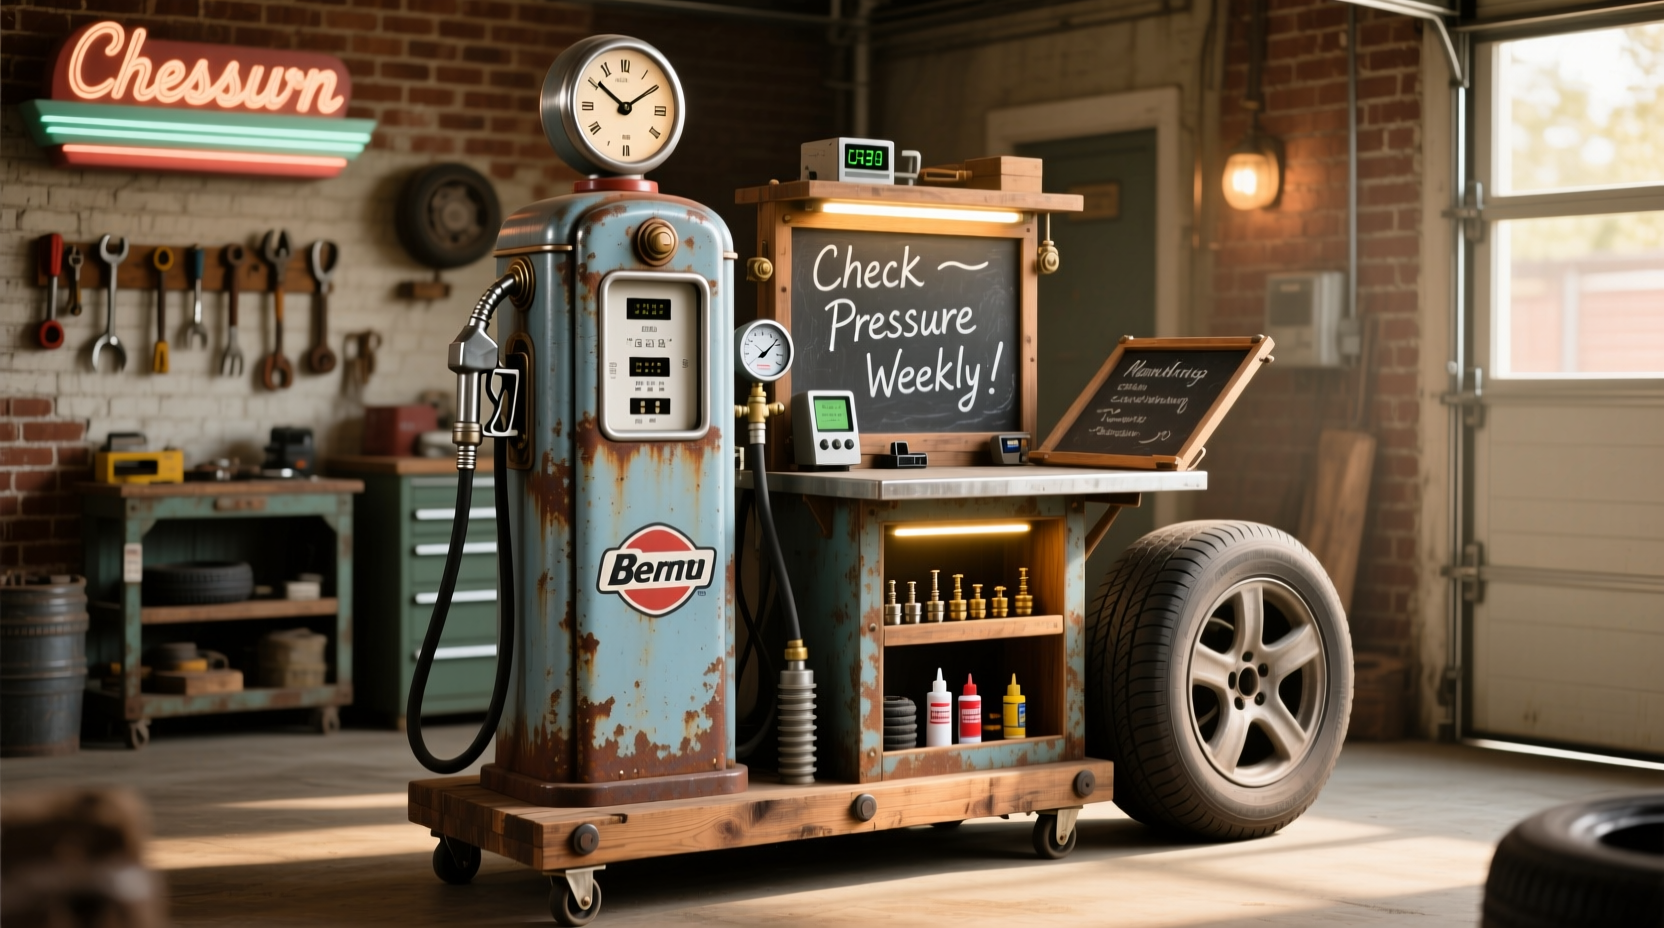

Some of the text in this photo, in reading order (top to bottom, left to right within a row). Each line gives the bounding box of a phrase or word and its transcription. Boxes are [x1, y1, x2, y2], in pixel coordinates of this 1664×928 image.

[812, 244, 925, 291] Check
[824, 298, 977, 352] Pressure
[866, 341, 1004, 412] Weekly!
